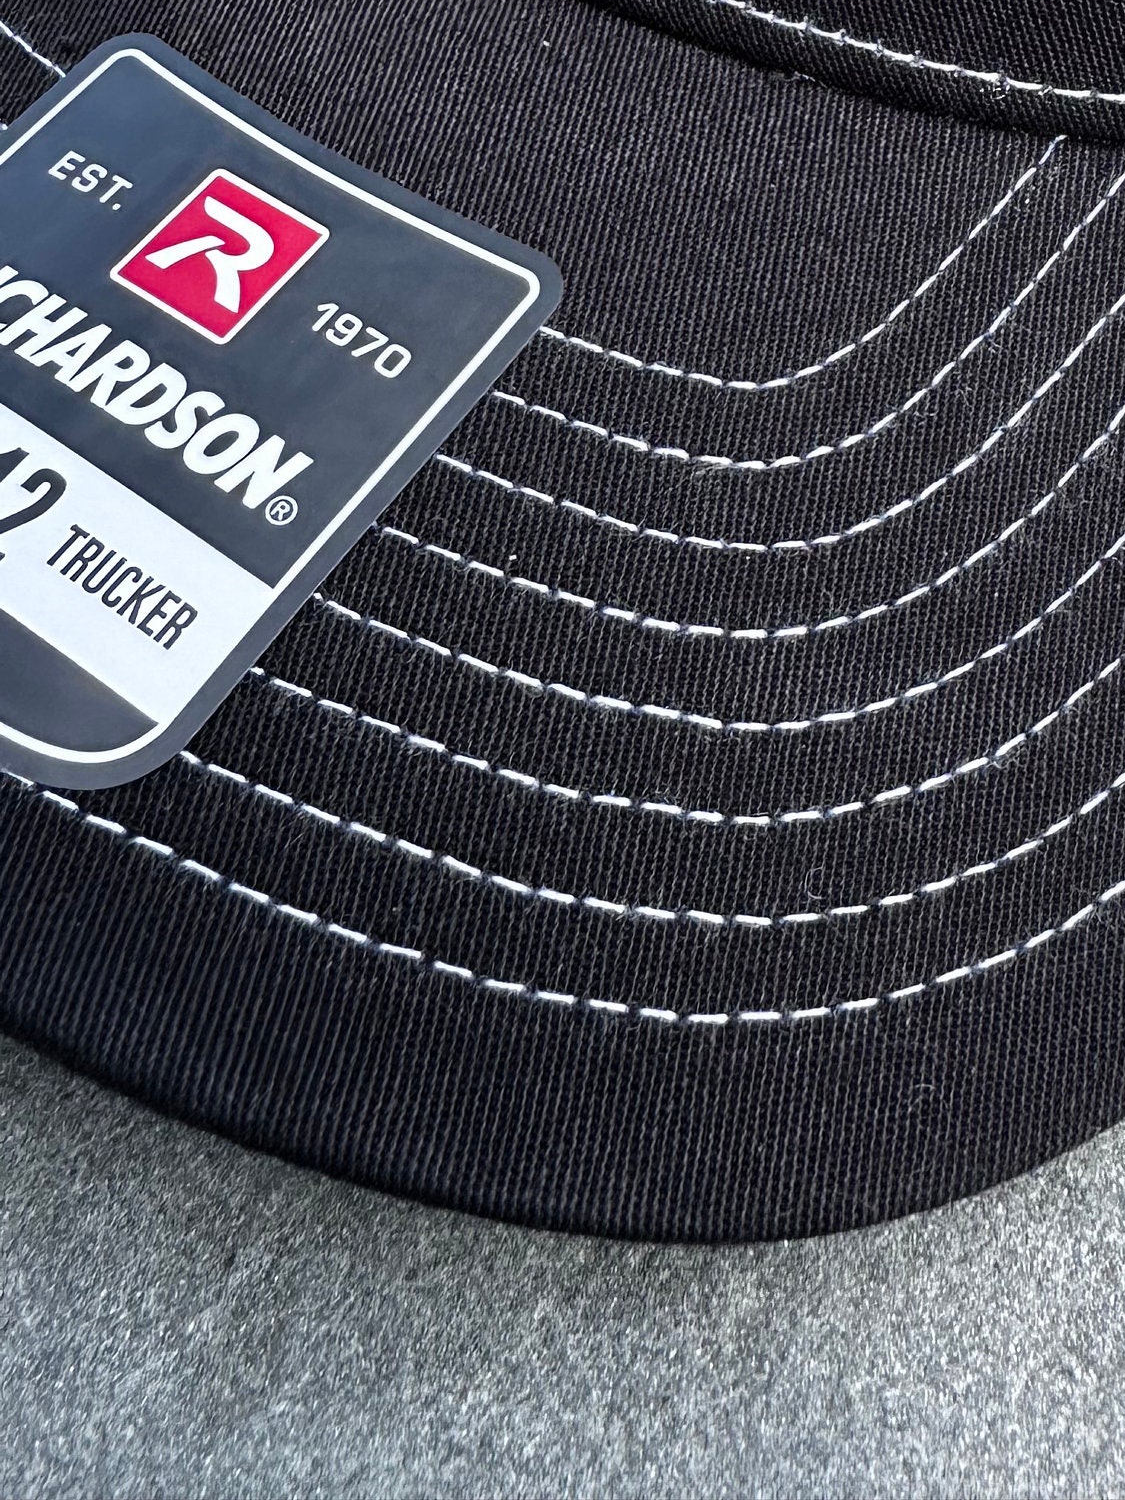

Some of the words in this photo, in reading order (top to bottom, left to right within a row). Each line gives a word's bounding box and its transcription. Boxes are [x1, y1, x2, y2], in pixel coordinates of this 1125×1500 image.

[47, 150, 133, 211] EST.
[311, 302, 412, 379] 1970
[145, 195, 275, 314] R
[46, 523, 198, 650] TRUCKER
